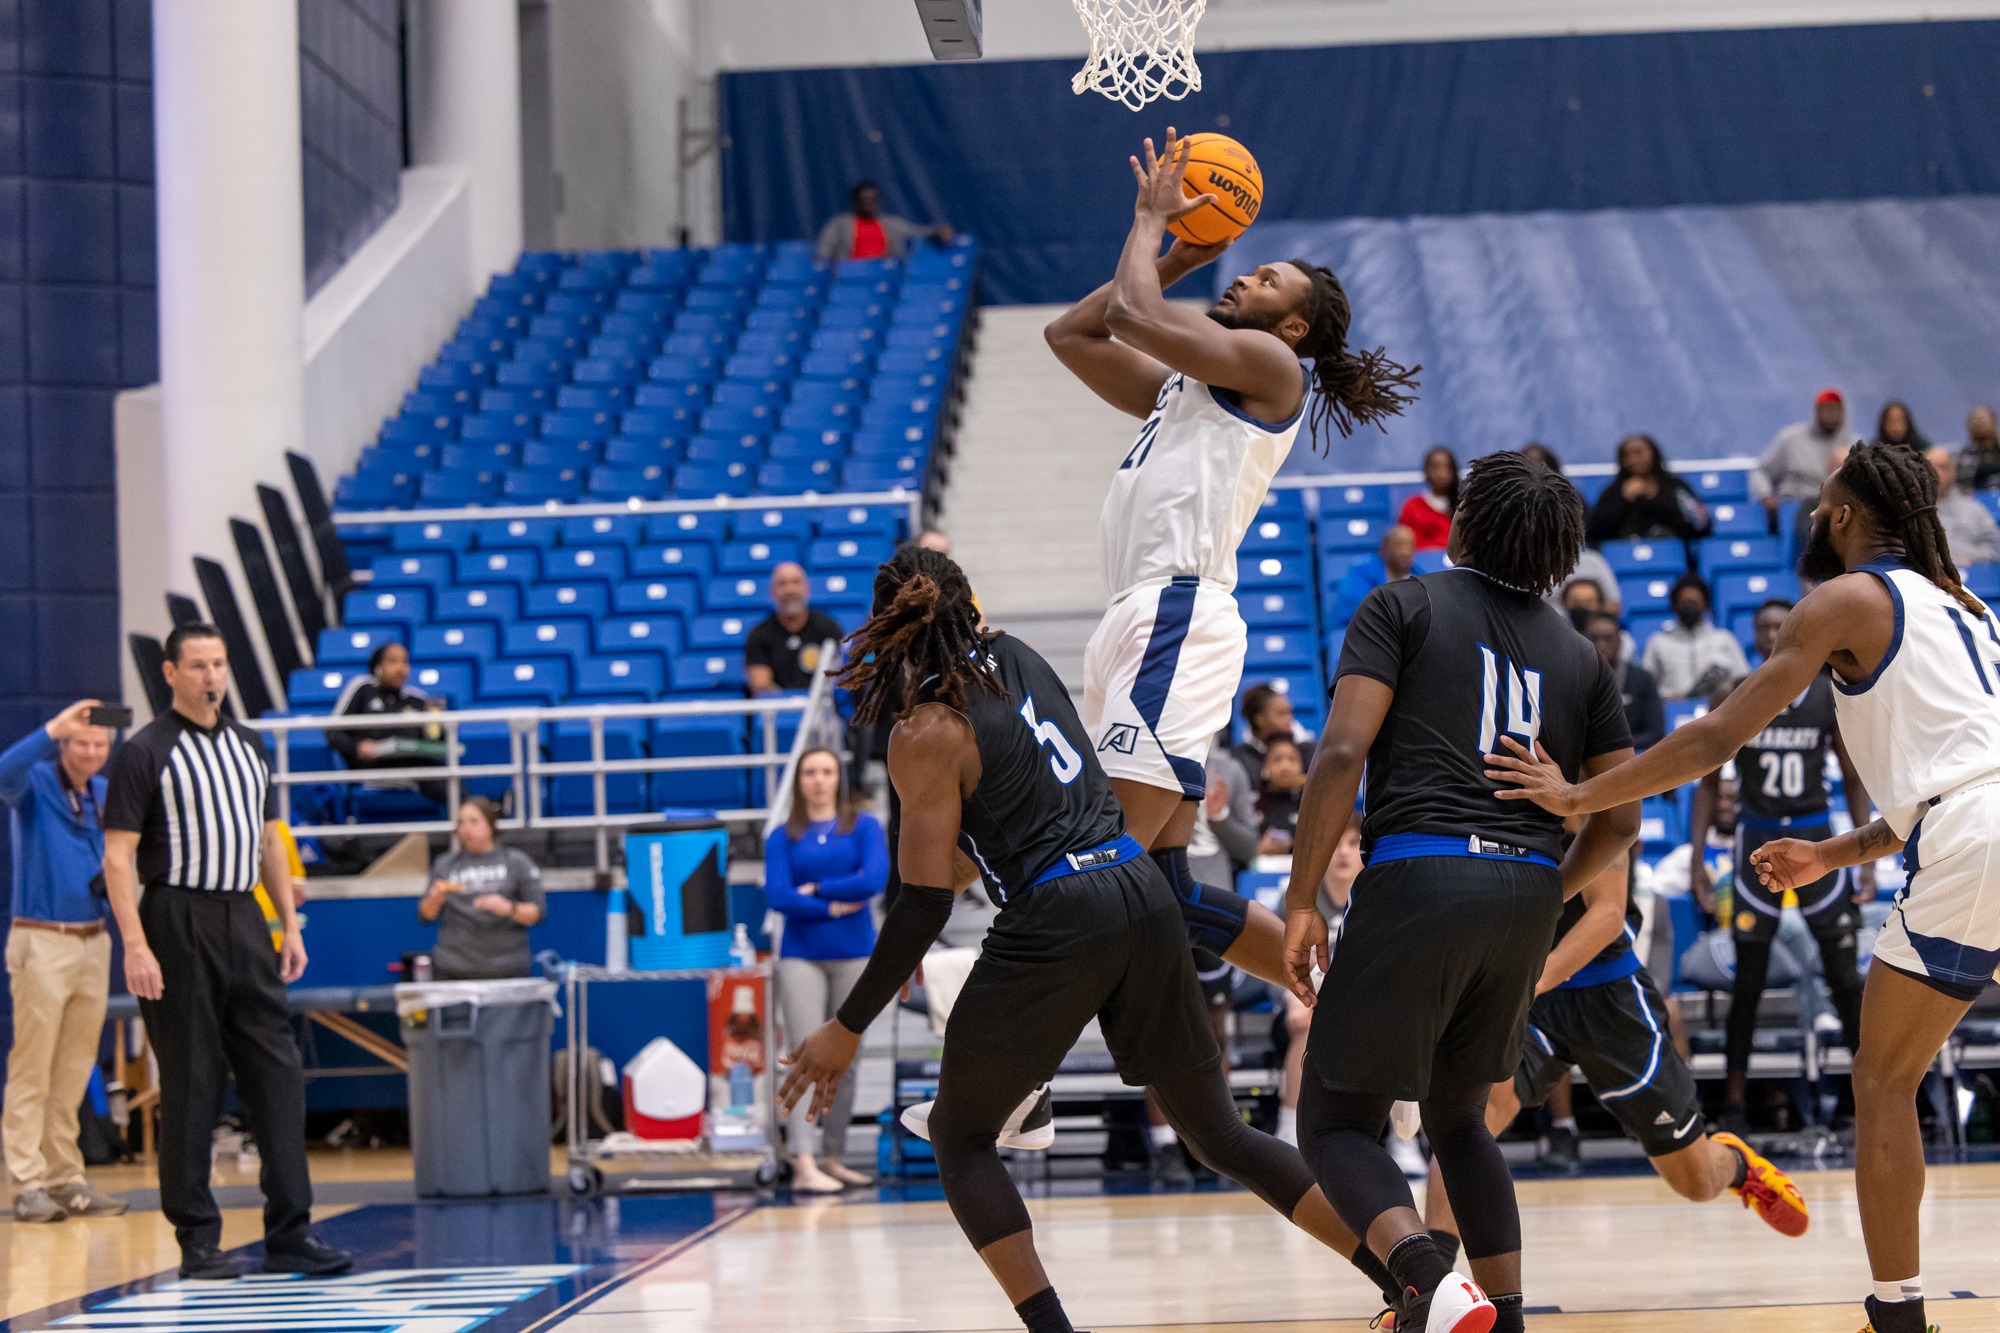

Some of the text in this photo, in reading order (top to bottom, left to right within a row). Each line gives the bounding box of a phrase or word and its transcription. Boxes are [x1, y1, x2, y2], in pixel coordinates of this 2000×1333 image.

[1208, 170, 1260, 221] Wilson
[1017, 690, 1085, 787] 5
[1476, 641, 1543, 762] 14
[1758, 751, 1805, 798] 20
